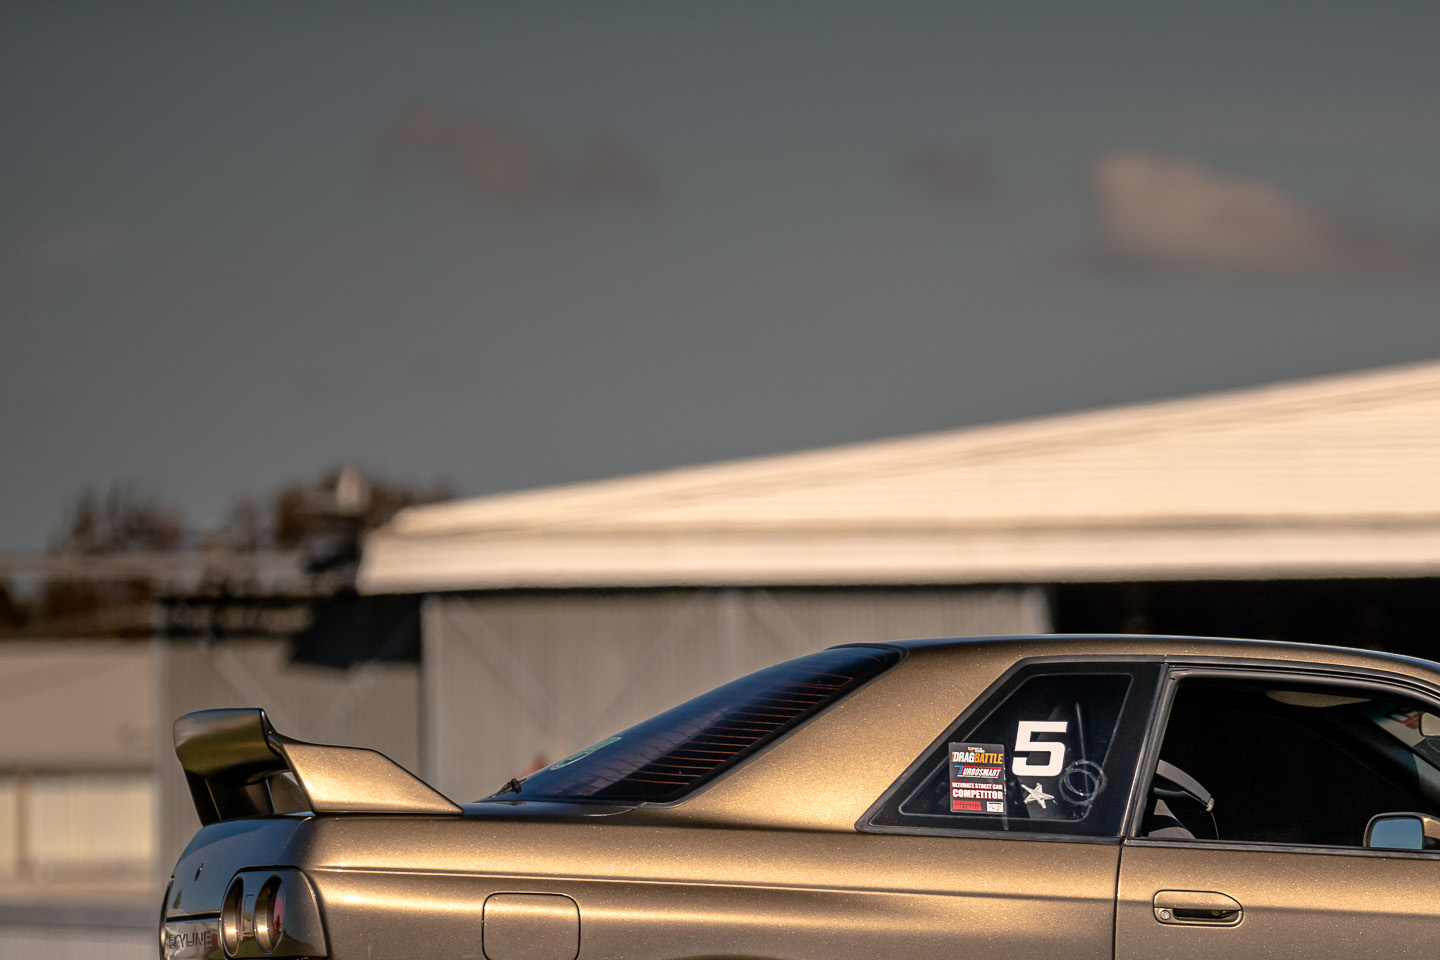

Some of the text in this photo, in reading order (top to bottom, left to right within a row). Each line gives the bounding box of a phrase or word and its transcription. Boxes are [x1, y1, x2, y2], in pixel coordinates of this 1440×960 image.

[1013, 721, 1067, 776] 5
[952, 789, 1003, 799] COMPETITOR
[169, 931, 212, 950] SKYLINE
